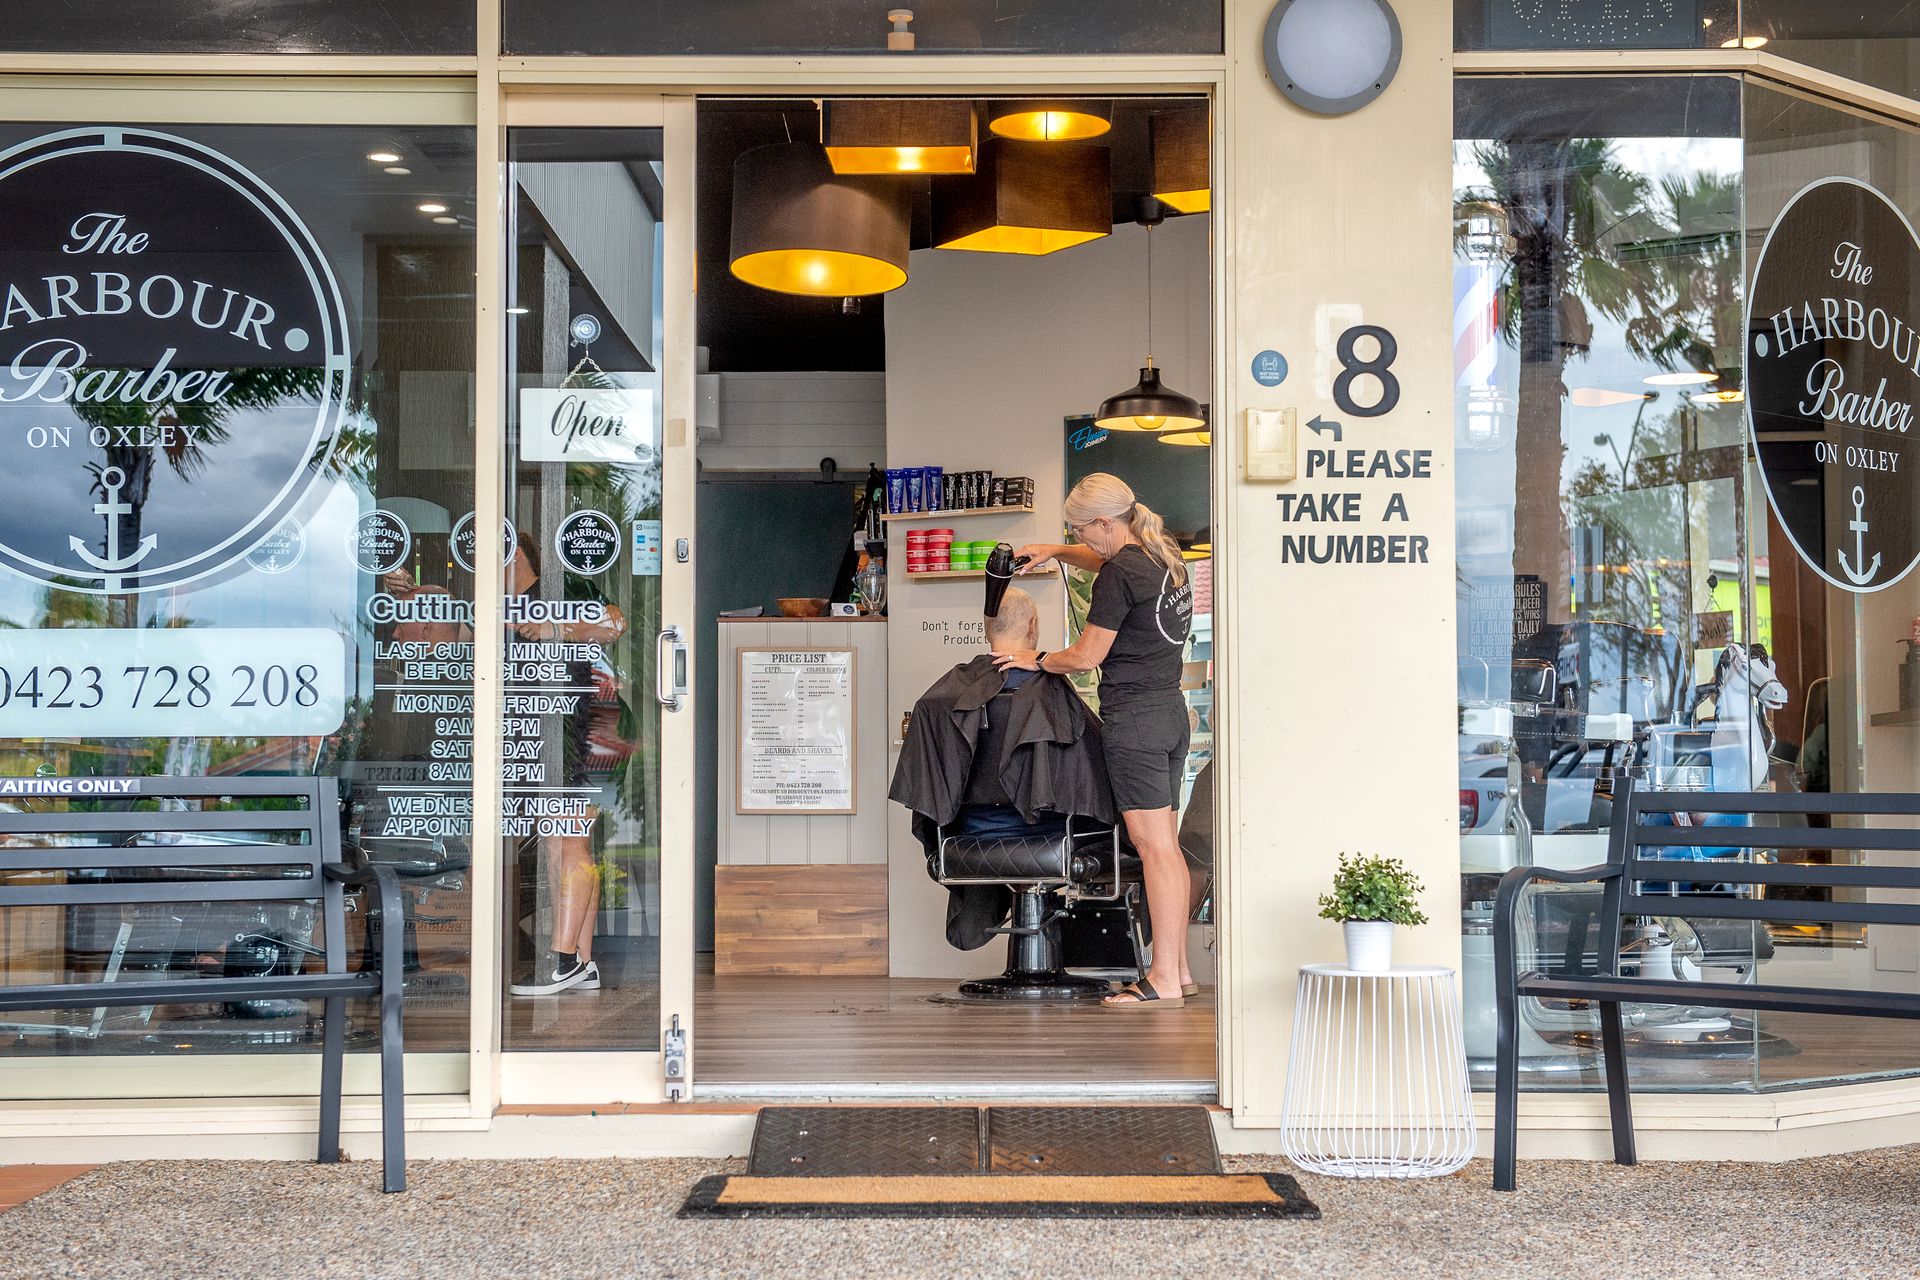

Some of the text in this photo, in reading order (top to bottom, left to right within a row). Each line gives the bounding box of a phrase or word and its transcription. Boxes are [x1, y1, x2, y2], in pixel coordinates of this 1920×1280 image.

[62, 212, 149, 255] The
[1831, 241, 1873, 286] The
[0, 271, 272, 350] ARBOUR
[0, 338, 234, 403] Barber
[1332, 324, 1400, 418] 8
[1799, 358, 1914, 434] Barber
[551, 394, 627, 454] Open
[26, 426, 200, 448] ON OXLEY
[1306, 450, 1432, 478] PLEASE
[1815, 441, 1900, 473] ON OXLEY
[1276, 493, 1409, 522] TAKE A
[367, 517, 387, 527] The
[578, 517, 597, 527] The
[355, 528, 401, 541] HARBOUR
[360, 538, 396, 548] Barber
[565, 528, 612, 542] HARBOUR
[571, 538, 606, 548] Barber
[1281, 535, 1429, 564] NUMBER
[1515, 583, 1540, 598] RULES
[503, 594, 602, 624] Hours
[1523, 598, 1540, 609] BEER
[1524, 609, 1540, 620] WINS
[922, 620, 984, 632] Don't forg
[1471, 622, 1485, 634] EAT
[1518, 621, 1540, 634] DAILY
[375, 641, 431, 660] LAST
[509, 642, 602, 661] MINUTES
[772, 654, 827, 663] PRICE LIST
[405, 662, 572, 682] BEFOR CLOSE.
[123, 665, 211, 709] 728
[230, 664, 319, 708] 208
[397, 695, 580, 714] MONDA FRIDAY
[429, 762, 473, 781] 8AM
[502, 763, 545, 782] 2PM
[77, 779, 133, 793] ONLY
[525, 797, 590, 817] NIGHT
[537, 818, 596, 838] ONLY
